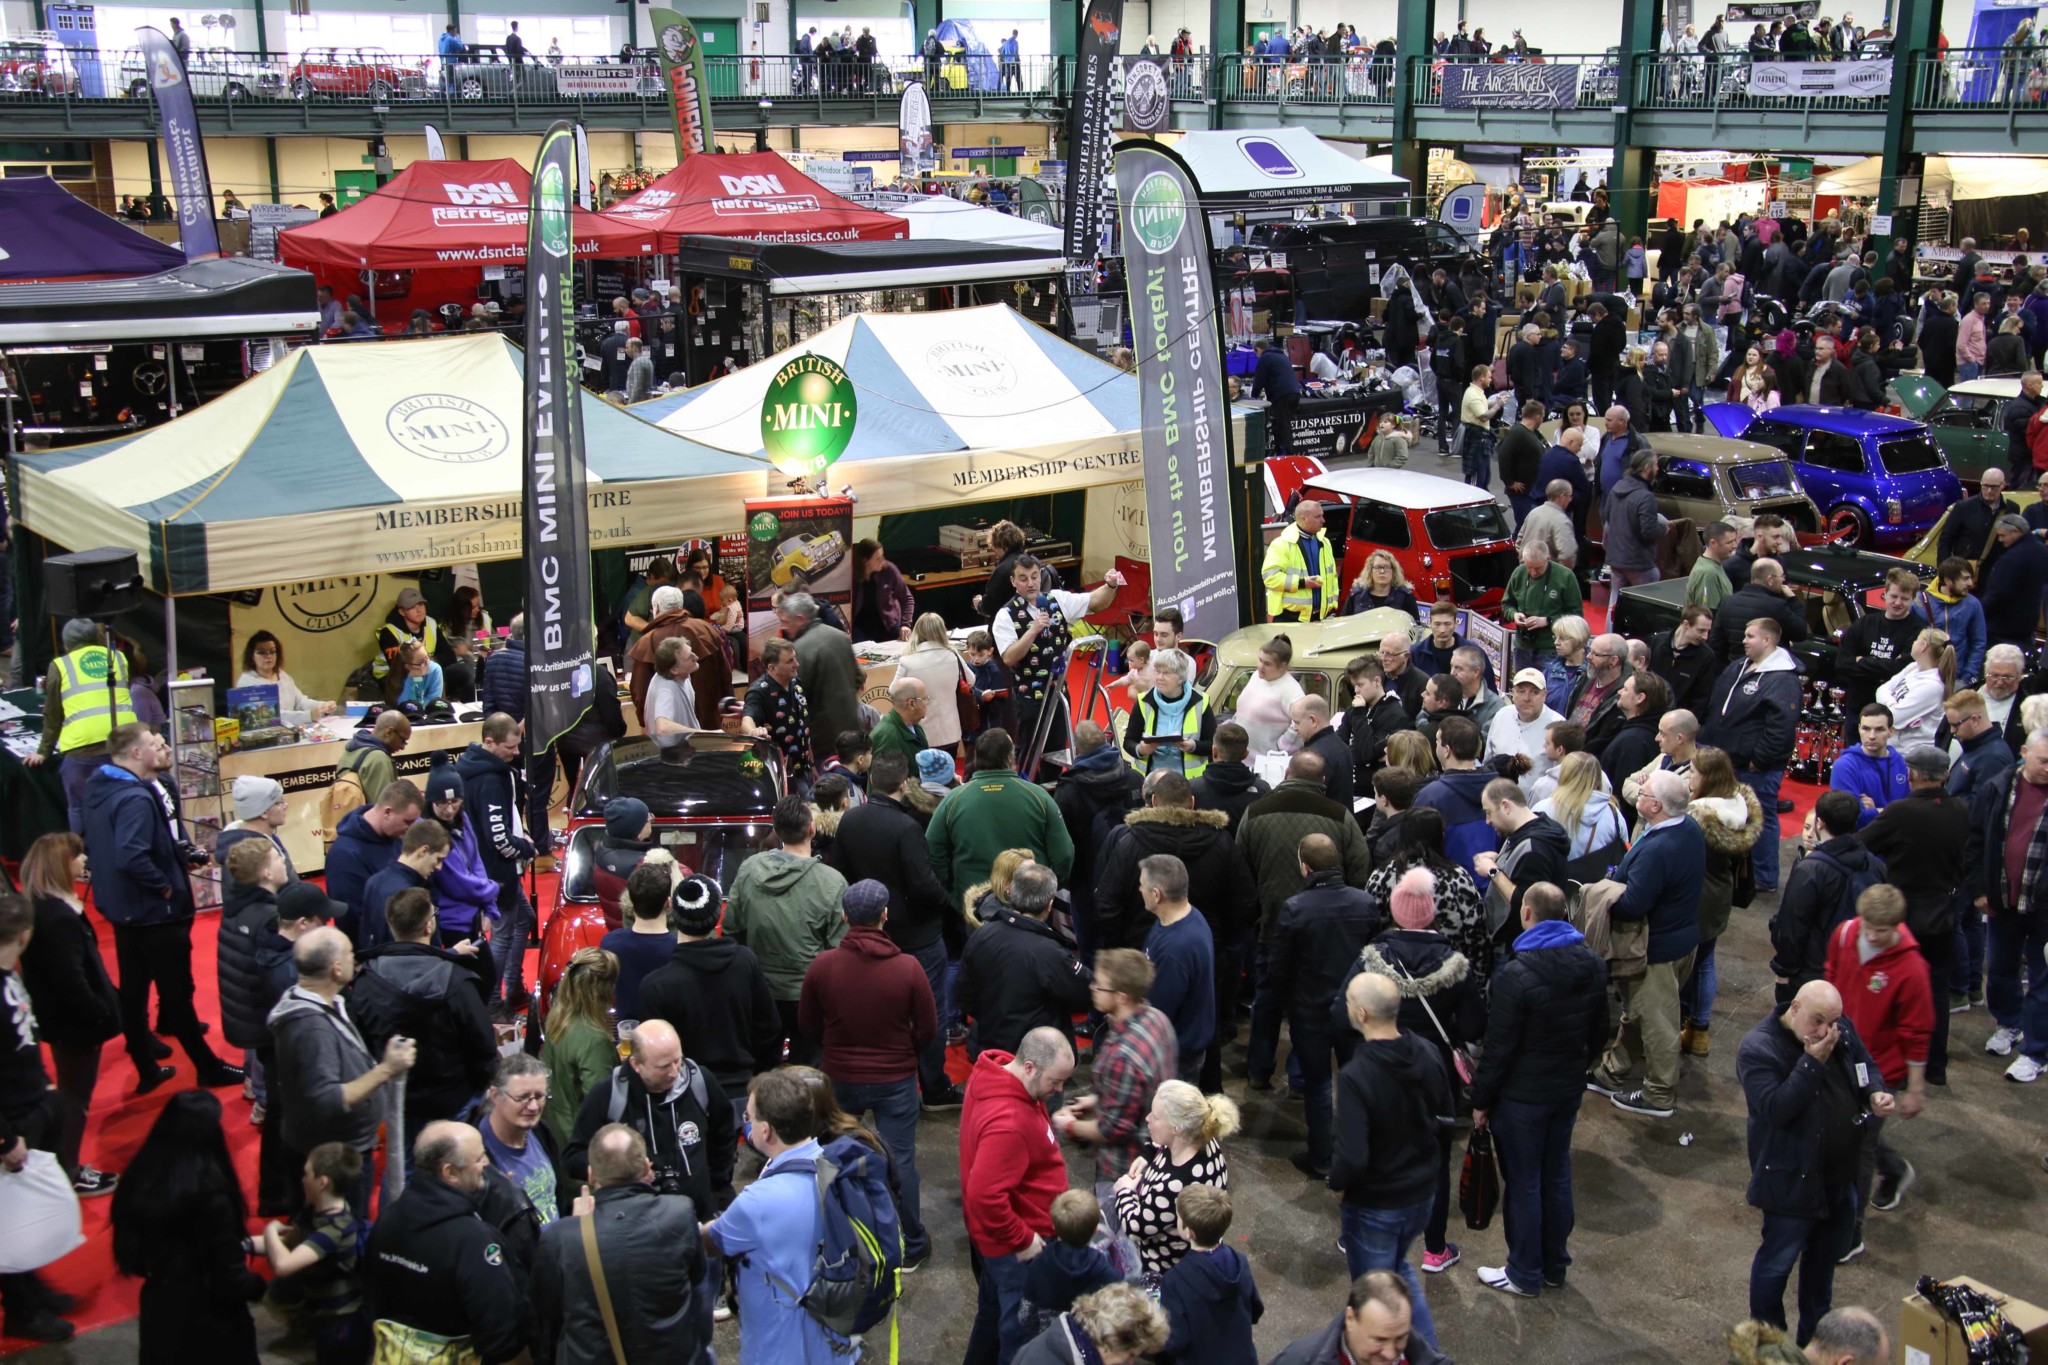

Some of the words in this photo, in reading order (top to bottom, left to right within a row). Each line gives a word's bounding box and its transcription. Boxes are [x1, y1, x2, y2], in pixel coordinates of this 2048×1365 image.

[597, 69, 627, 78] BITS
[567, 81, 628, 89] minibitsuk.co.uk
[1073, 123, 1092, 254] HUDDERSFIELD
[1084, 54, 1098, 120] SPARES
[1086, 84, 1104, 236] www.minispares-online.co.uk
[443, 182, 519, 206] DSN
[719, 175, 786, 195] DSN
[1249, 189, 1286, 198] AUTOMOTIVE
[1287, 187, 1313, 196] INTERIOR
[1314, 186, 1327, 194] TRIM
[1333, 185, 1352, 193] AUDIO
[1981, 249, 2003, 260] lassic
[776, 357, 844, 388] BRITISH
[942, 360, 1001, 377] MINI
[395, 396, 473, 416] BRITISH
[772, 402, 842, 431] MINI
[1308, 415, 1342, 428] SPARES
[1343, 413, 1361, 424] LTD
[406, 420, 488, 440] MINI
[443, 449, 493, 462] CLUB
[953, 460, 1067, 487] MEMBERSHIP
[1073, 450, 1141, 472] CENTRE
[535, 452, 558, 543] MINI
[778, 510, 799, 519] JOIN
[801, 509, 814, 517] US
[816, 507, 850, 516] TODAY!!
[754, 523, 775, 531] MINI
[541, 555, 563, 651] BMC
[306, 611, 350, 629] CLUB
[560, 681, 571, 691] on:
